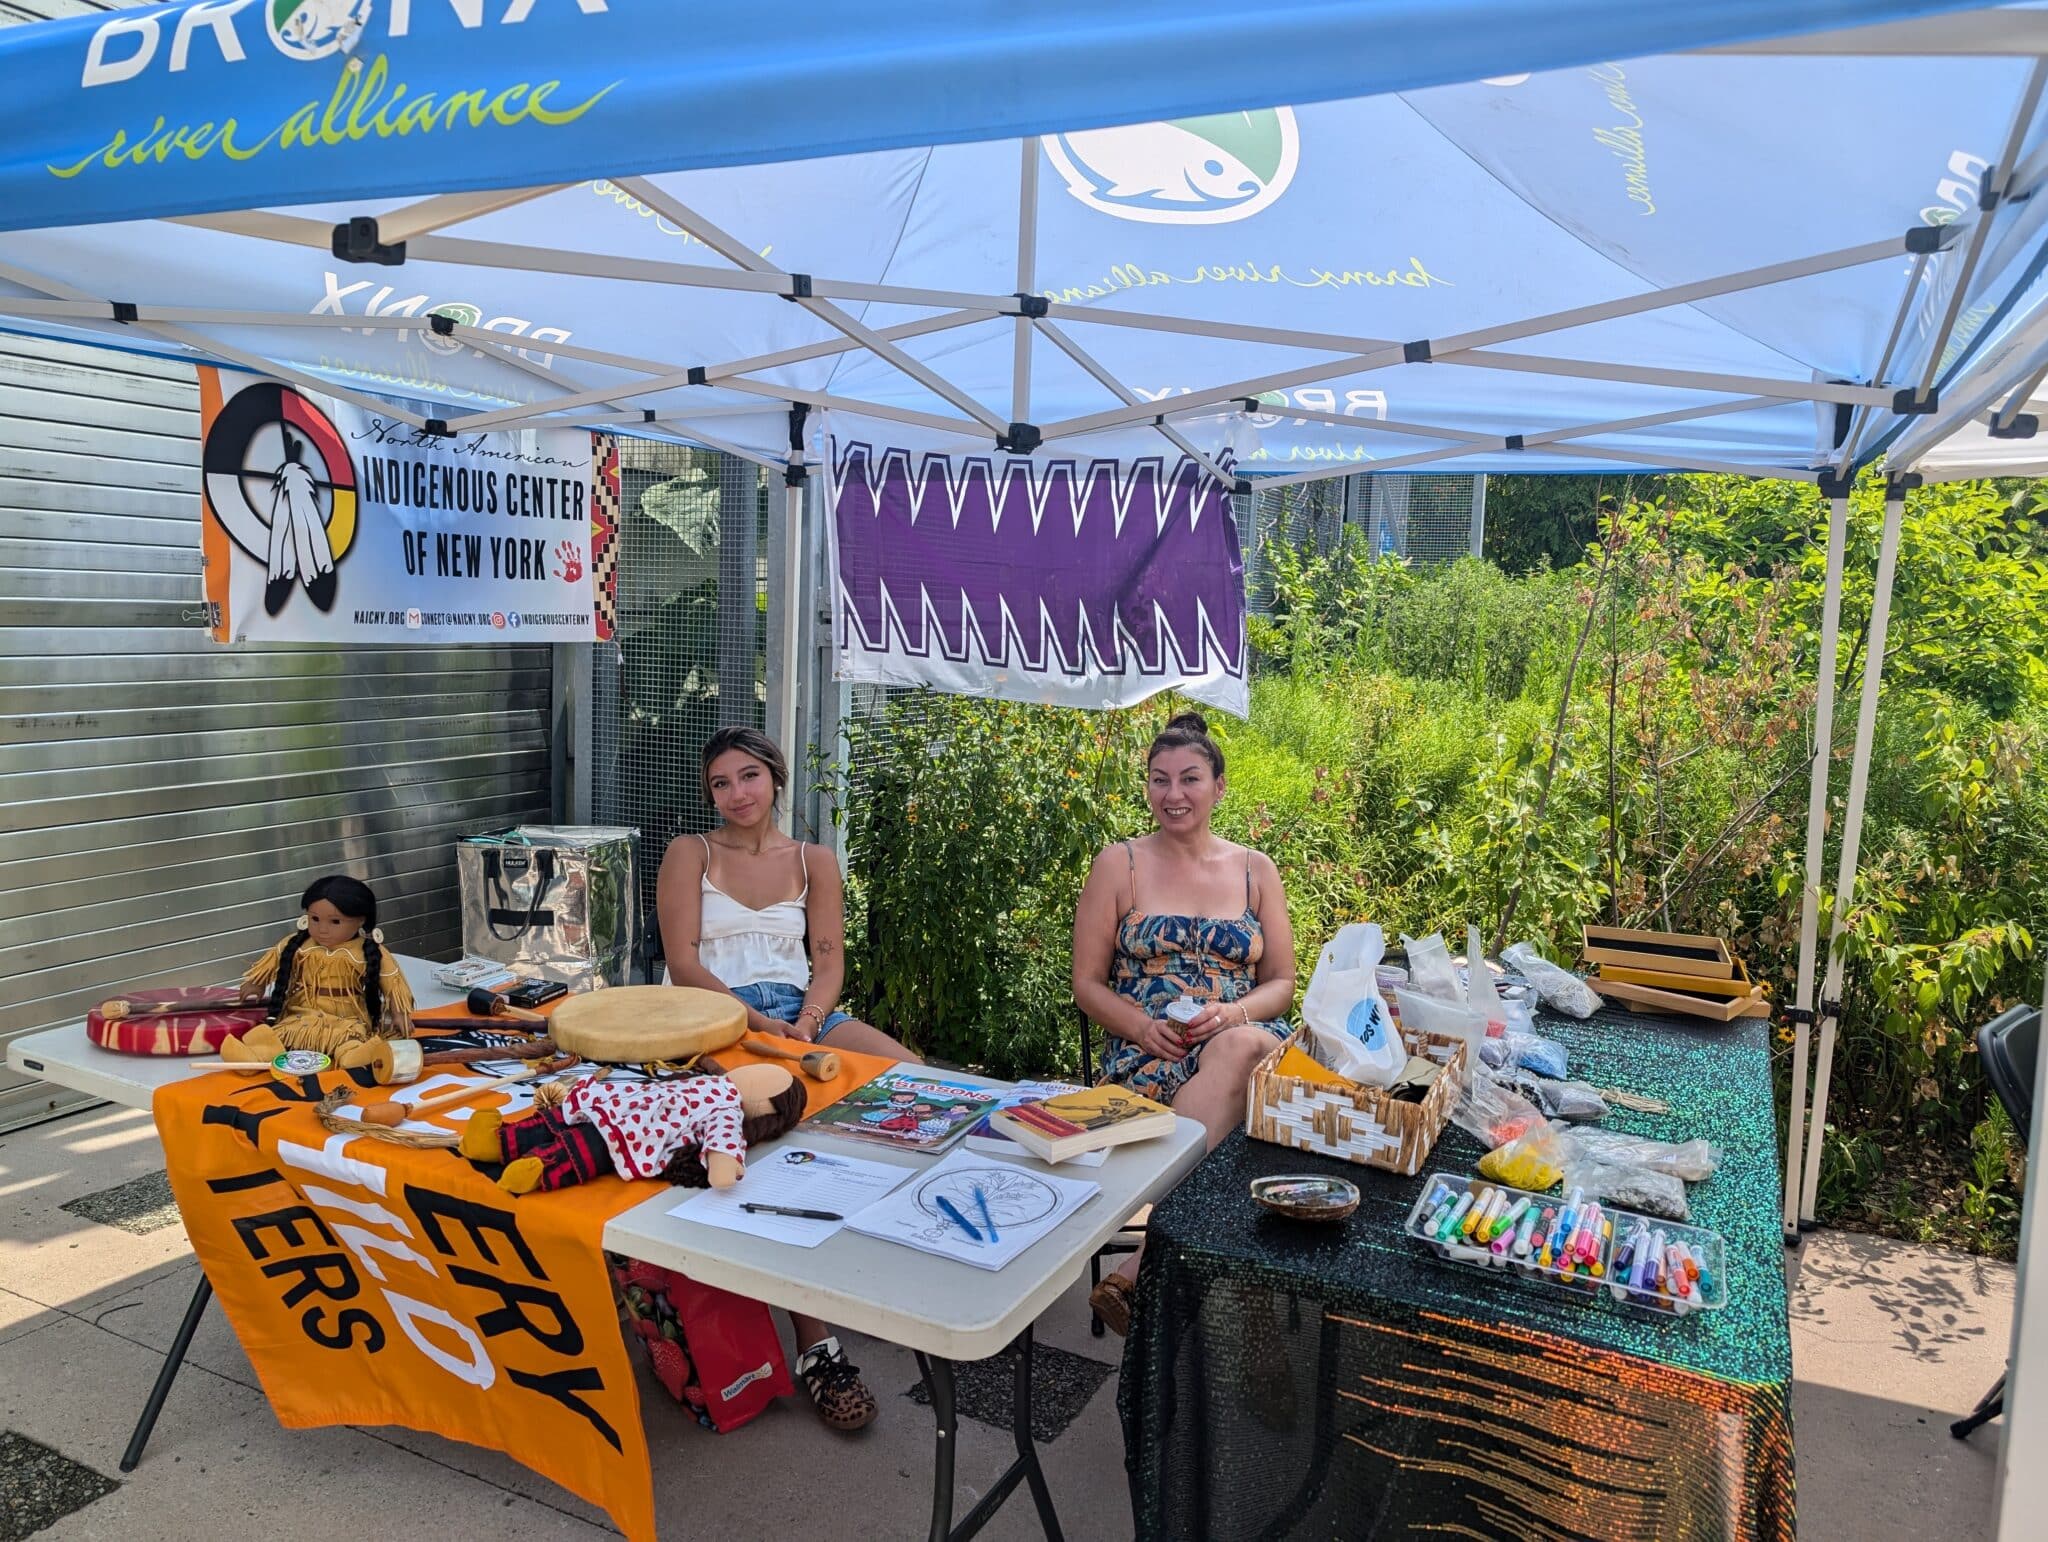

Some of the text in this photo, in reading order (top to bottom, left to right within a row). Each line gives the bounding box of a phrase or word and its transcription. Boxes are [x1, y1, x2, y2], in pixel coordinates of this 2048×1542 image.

[47, 54, 625, 178] river alliance
[454, 433, 590, 468] American
[362, 455, 584, 521] INDIGENOUS CENTER
[403, 530, 546, 581] OF NEW YORK
[353, 610, 405, 625] NAICNY.ORG
[893, 1080, 994, 1102] SEASONS
